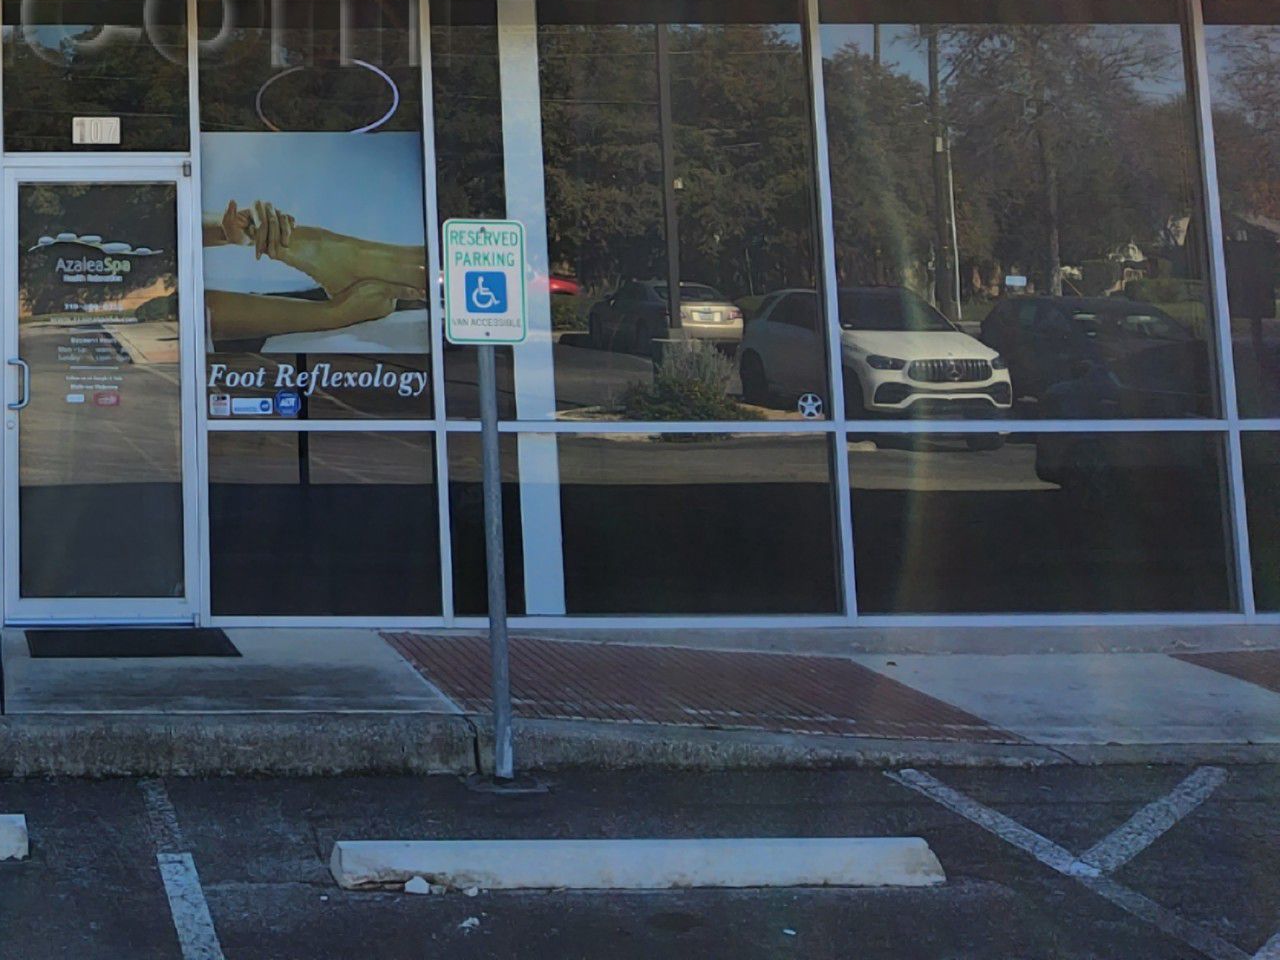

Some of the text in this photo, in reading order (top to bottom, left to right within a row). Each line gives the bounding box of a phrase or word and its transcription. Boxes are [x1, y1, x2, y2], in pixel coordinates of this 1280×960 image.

[449, 230, 518, 246] RESERVED
[455, 252, 515, 267] PARKING
[208, 363, 428, 396] Foot Reflexology
